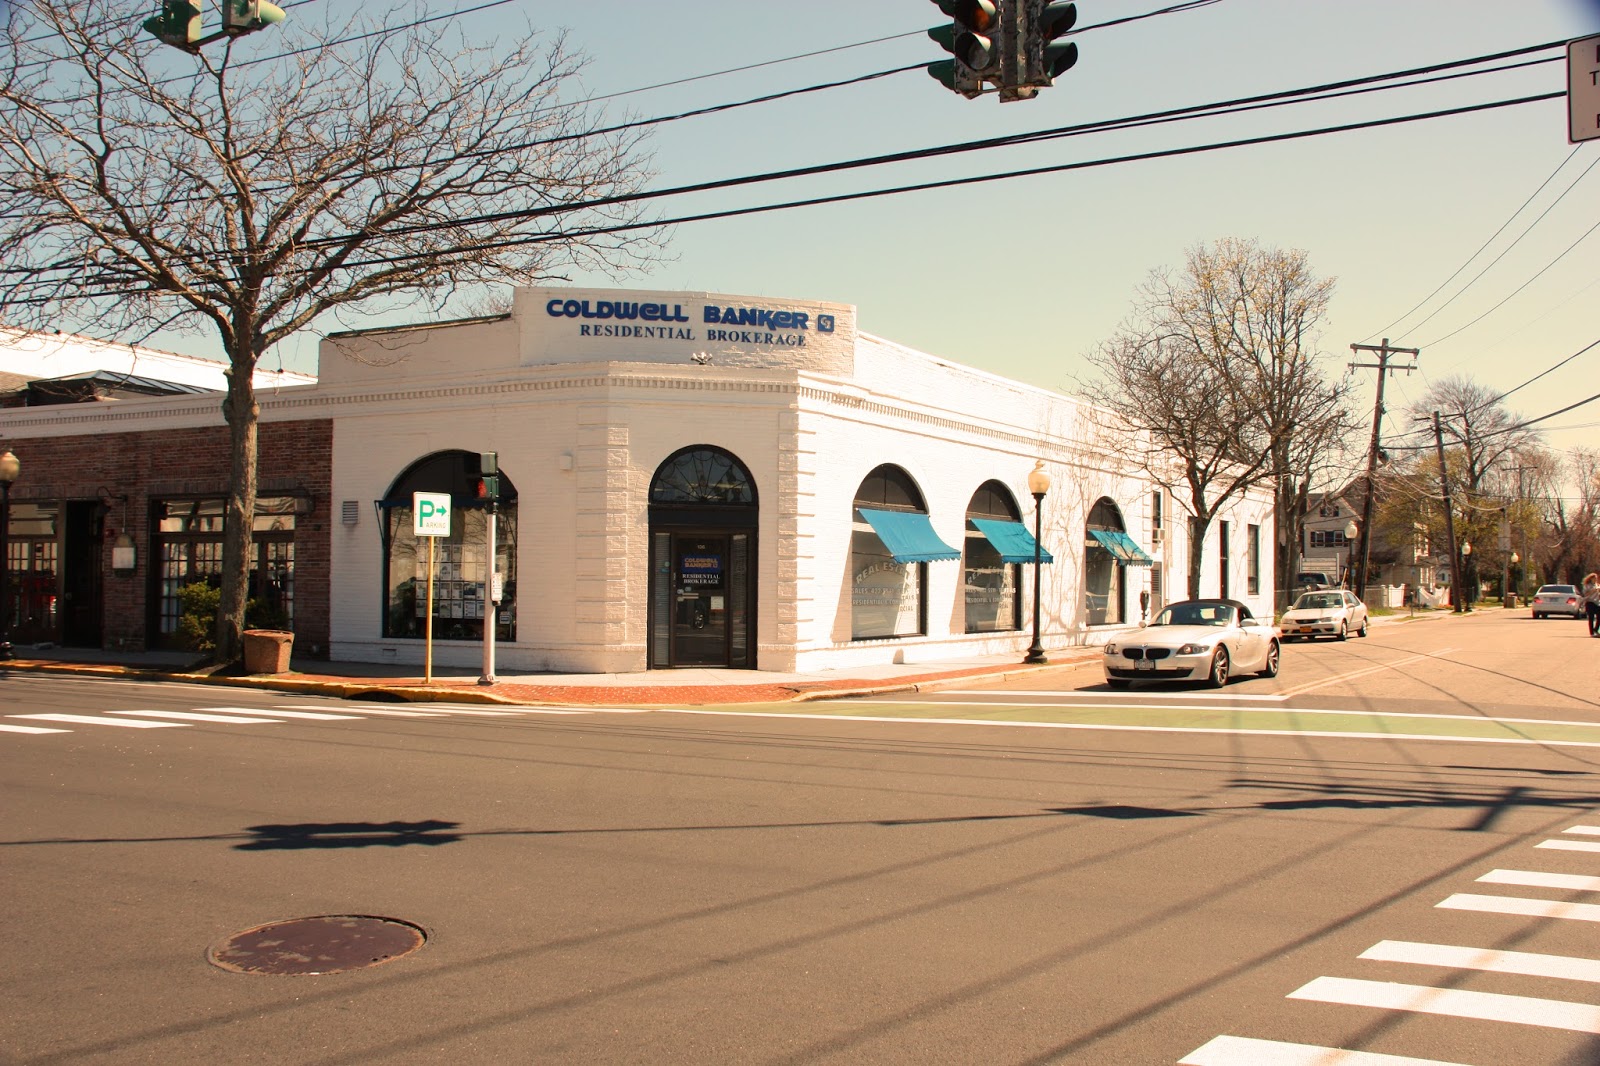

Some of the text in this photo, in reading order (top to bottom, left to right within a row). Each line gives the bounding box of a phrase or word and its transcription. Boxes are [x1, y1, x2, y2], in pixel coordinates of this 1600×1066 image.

[580, 324, 807, 346] RESIDENTIAL BROKERAGE
[856, 563, 880, 585] REAL
